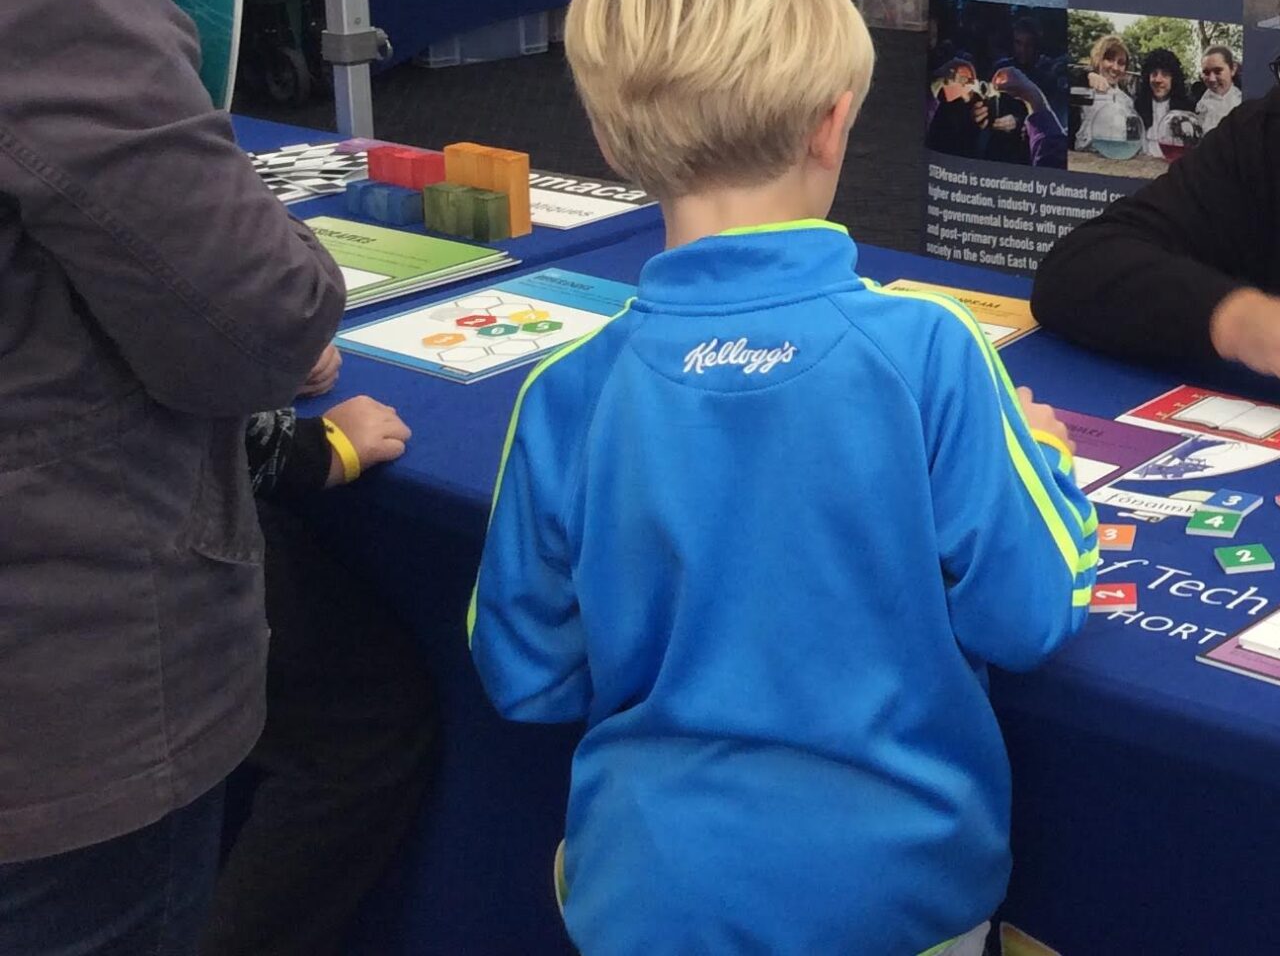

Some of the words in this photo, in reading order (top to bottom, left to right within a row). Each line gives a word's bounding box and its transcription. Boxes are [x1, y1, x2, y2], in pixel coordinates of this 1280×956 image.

[969, 172, 978, 187] is
[979, 176, 1034, 194] coordinated
[1036, 181, 1048, 197] by
[1049, 182, 1088, 199] Calmast
[1089, 188, 1108, 202] and
[1003, 215, 1034, 232] bodies
[1036, 220, 1057, 234] with
[940, 226, 997, 249] post-primary
[1000, 234, 1035, 251] schools
[953, 246, 962, 260] in
[963, 247, 978, 262] the
[979, 249, 1006, 266] South
[1007, 253, 1027, 269] East
[1028, 257, 1038, 271] to
[683, 338, 797, 374] Kellogg's
[1221, 495, 1242, 506] 3
[1203, 515, 1225, 527] 4
[1104, 529, 1118, 540] 3
[1235, 549, 1255, 562] 2
[1107, 609, 1227, 645] HORT
